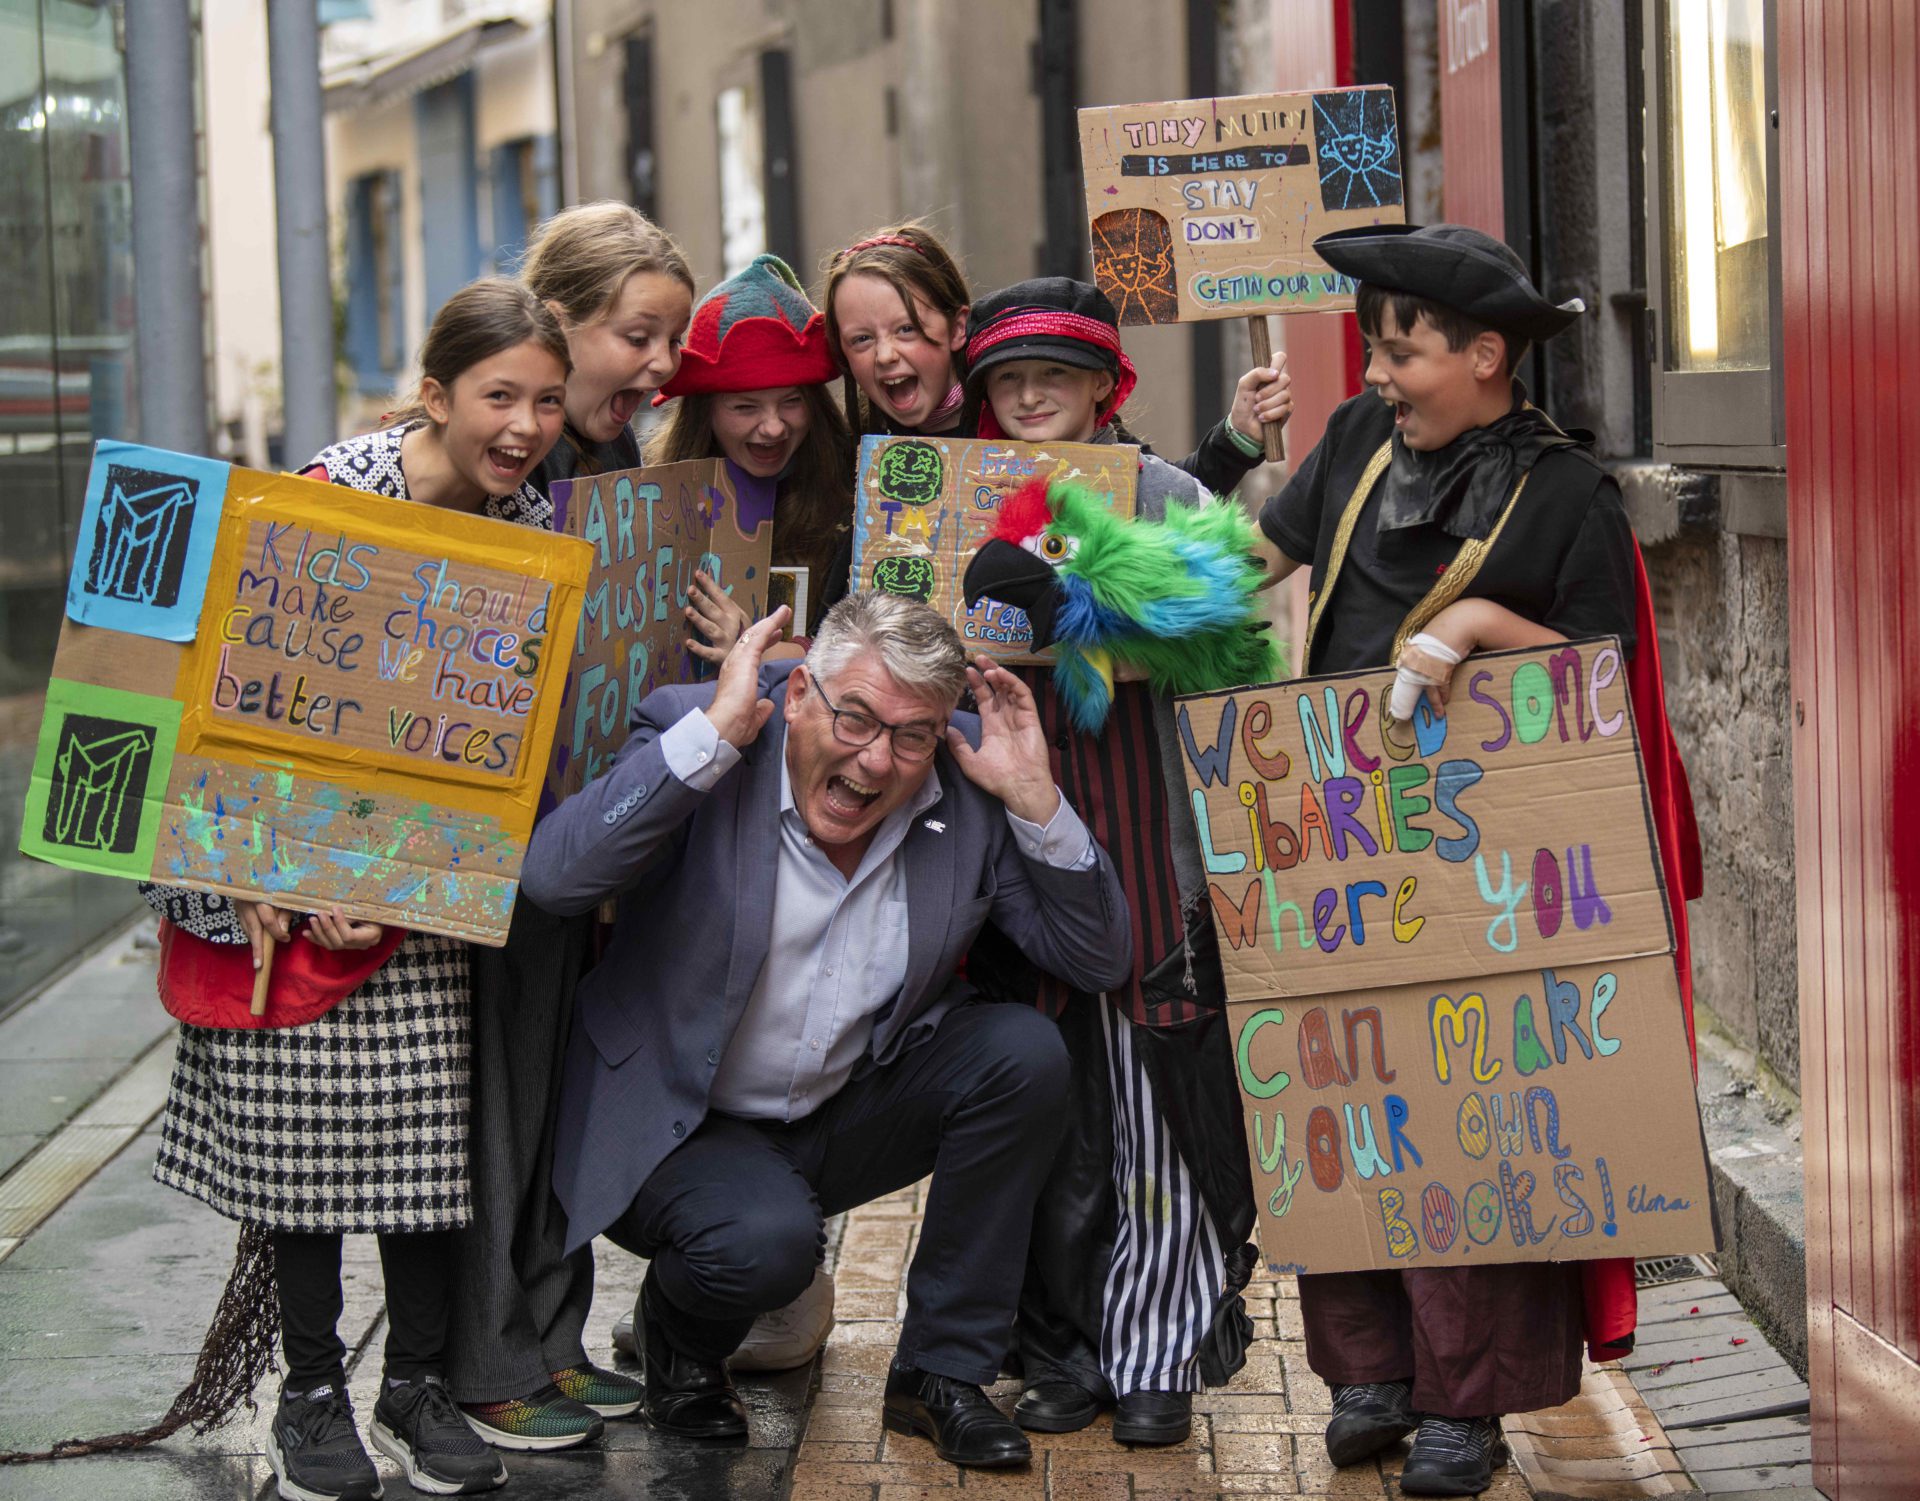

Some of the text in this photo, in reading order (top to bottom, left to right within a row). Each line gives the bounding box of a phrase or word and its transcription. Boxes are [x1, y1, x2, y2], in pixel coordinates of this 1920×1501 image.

[1123, 109, 1306, 148] TINY MUTINY
[1148, 152, 1288, 175] IS HERE TO
[1182, 177, 1258, 210] STAY
[1186, 218, 1255, 241] DON'T
[1268, 274, 1311, 297] OUR
[585, 476, 662, 568] ART
[220, 608, 364, 671] cause
[432, 651, 535, 716] have
[384, 601, 542, 678] choices
[213, 644, 363, 735] better
[388, 705, 521, 770] voices
[1178, 697, 1291, 788] We
